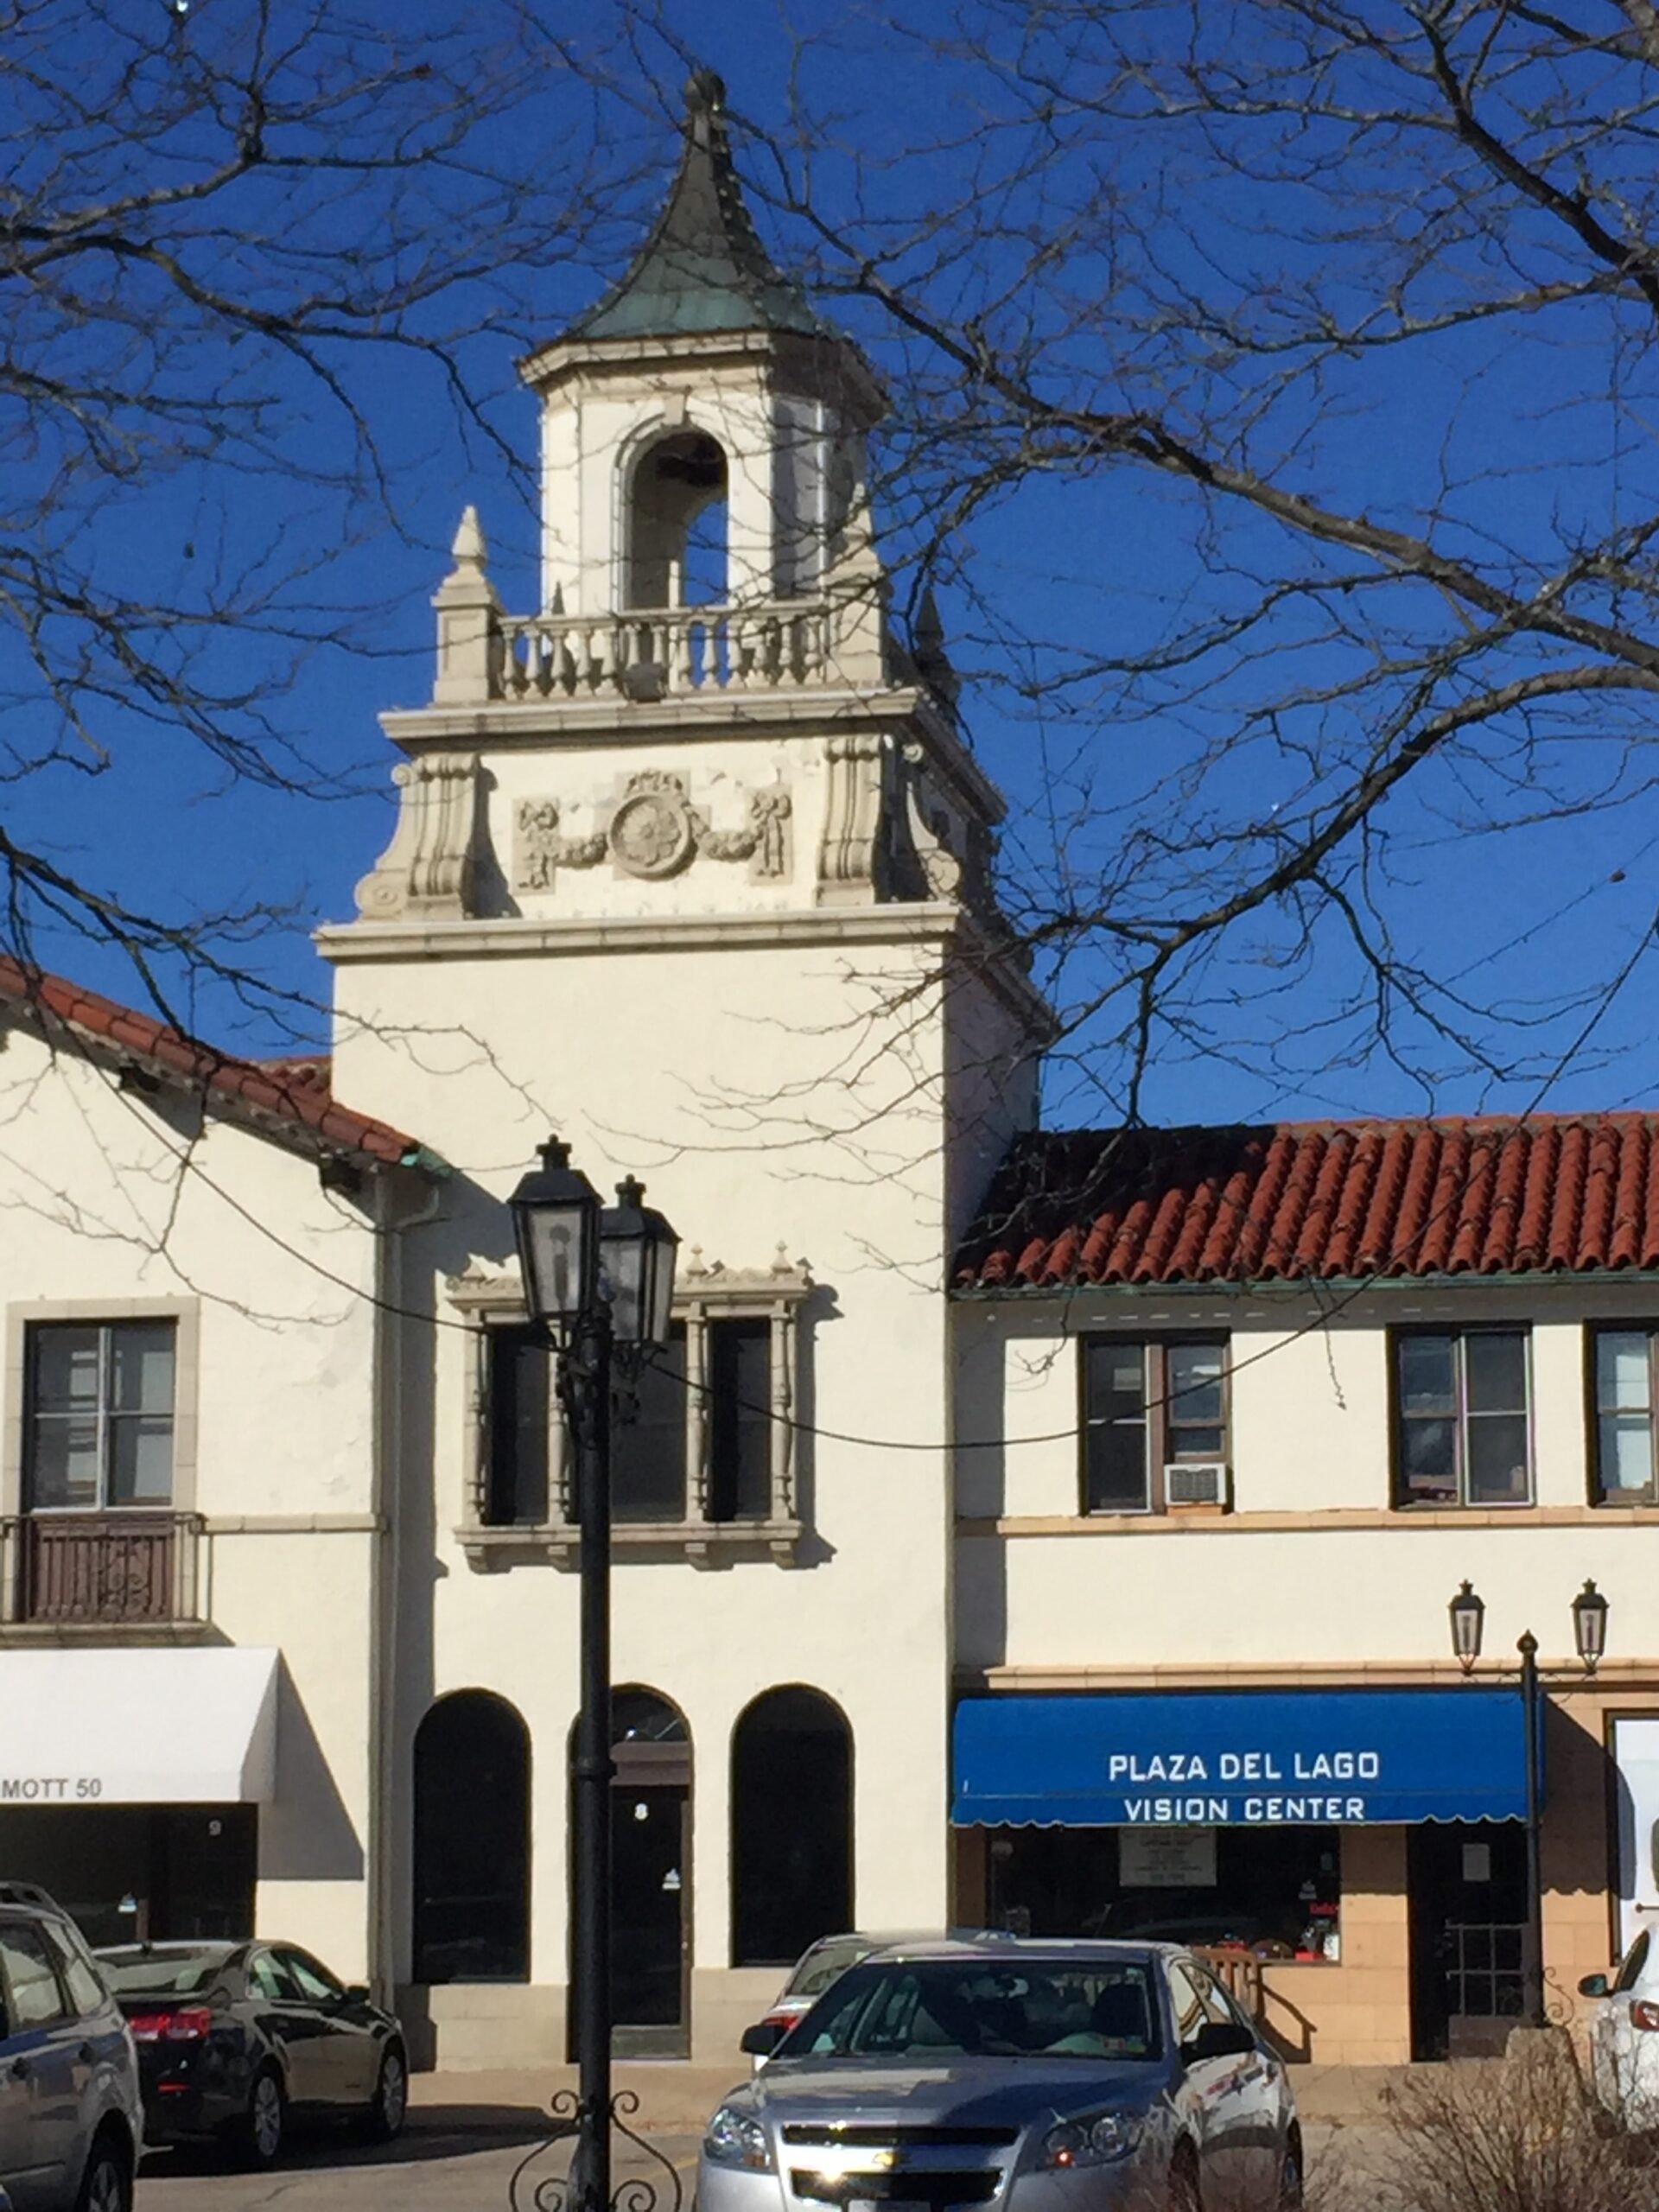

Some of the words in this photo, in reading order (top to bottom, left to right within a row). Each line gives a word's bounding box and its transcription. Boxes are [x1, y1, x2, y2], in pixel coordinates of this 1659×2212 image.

[1109, 1754, 1208, 1782] PLAZA
[1219, 1752, 1282, 1781] DEL
[1294, 1751, 1380, 1779] LAGO
[1, 1778, 69, 1799] MOTT
[75, 1777, 102, 1798] 50
[1123, 1798, 1229, 1821] VISION
[1243, 1796, 1365, 1821] CENTER
